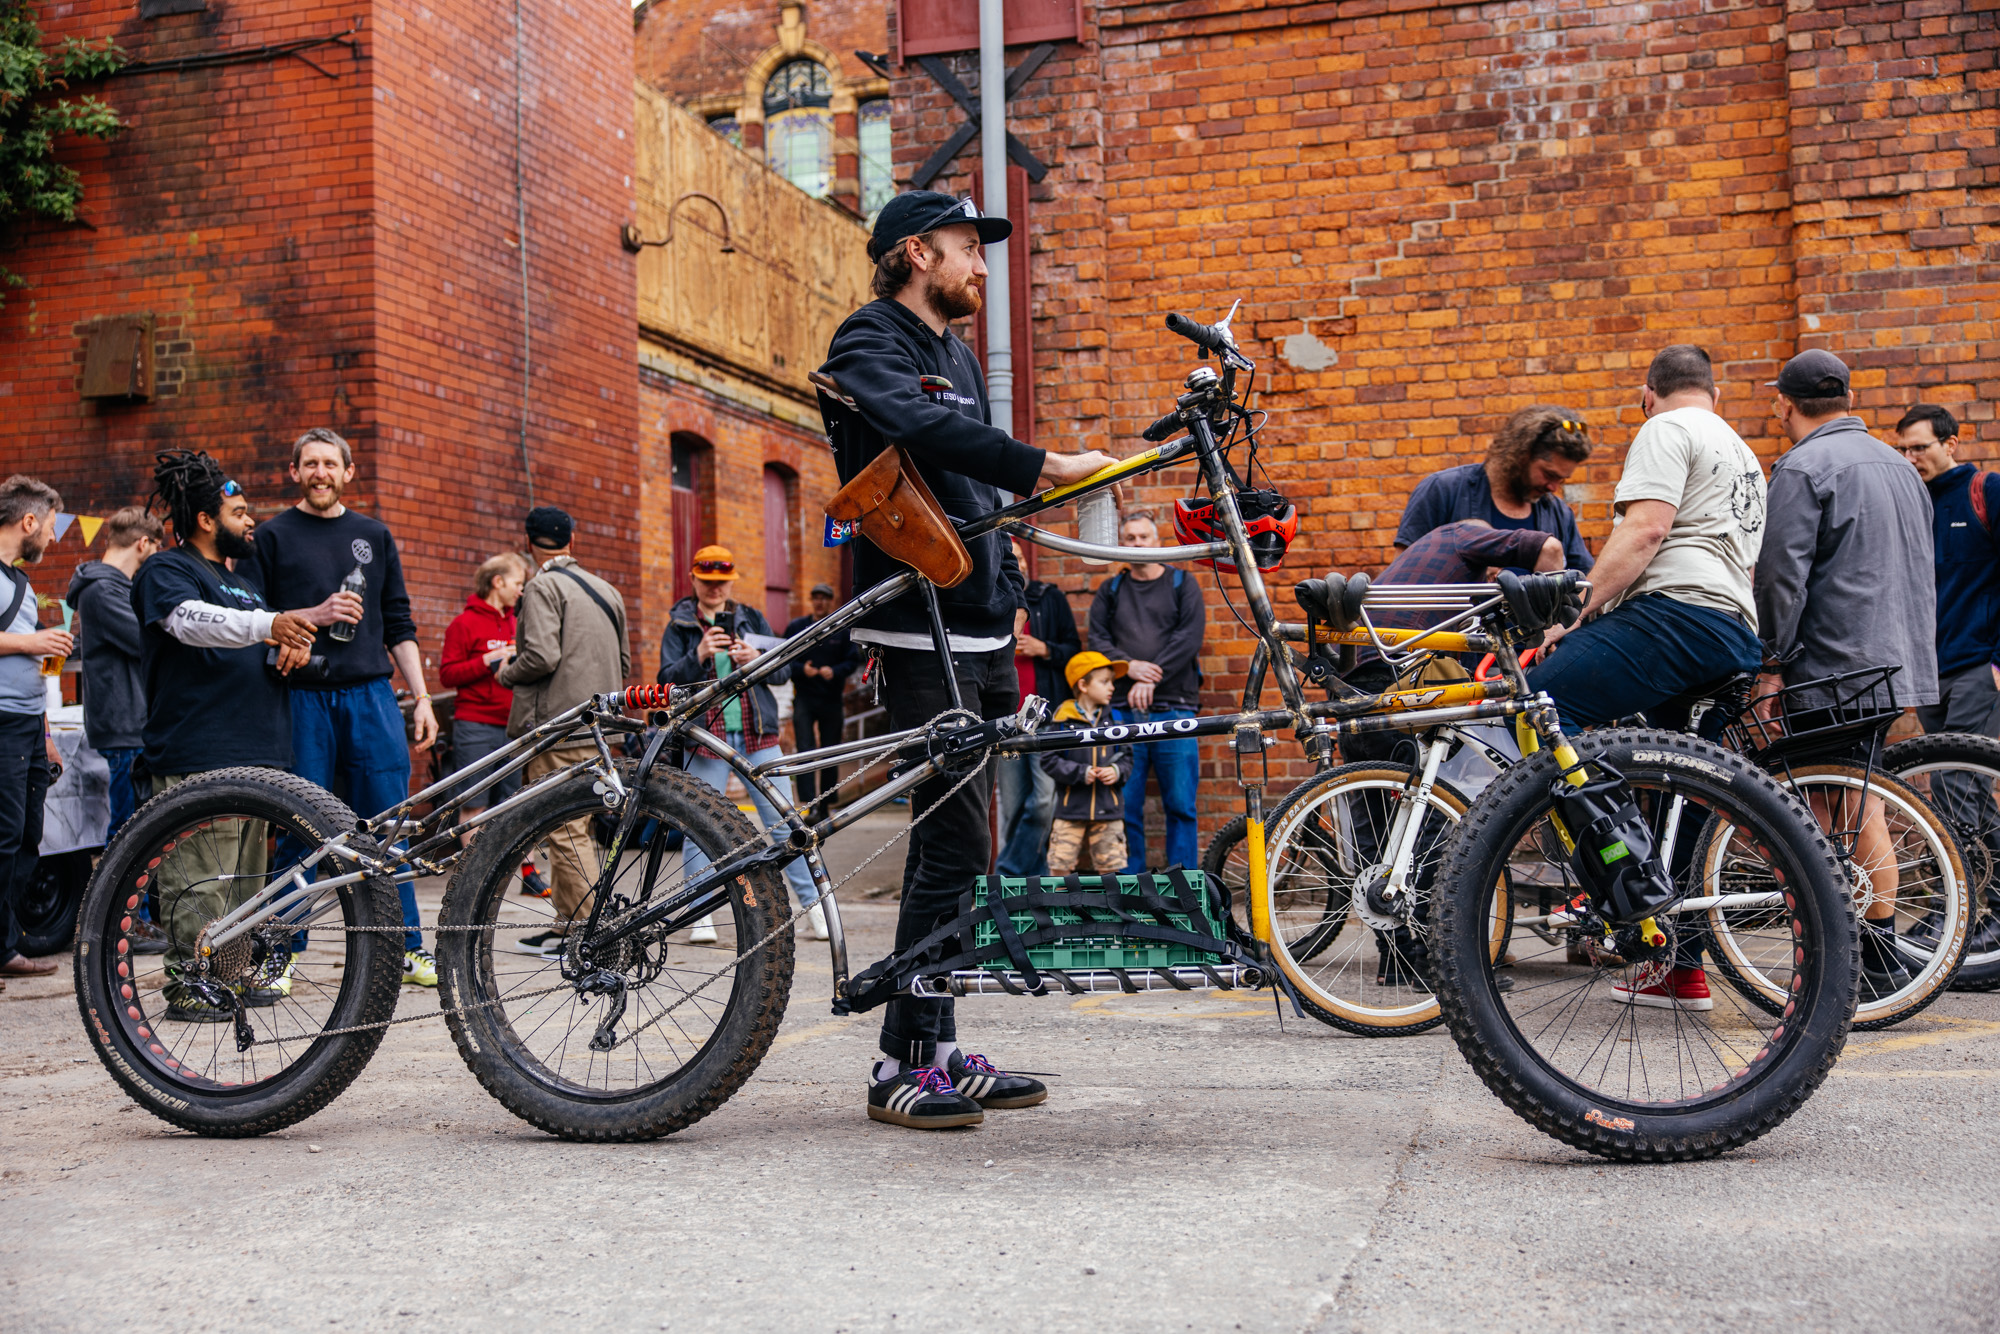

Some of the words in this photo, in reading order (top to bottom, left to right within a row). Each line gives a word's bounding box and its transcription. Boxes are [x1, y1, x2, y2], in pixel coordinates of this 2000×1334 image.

[965, 732, 984, 743] SRAM
[1075, 718, 1199, 743] TOMO
[1956, 879, 1969, 936] HALO
